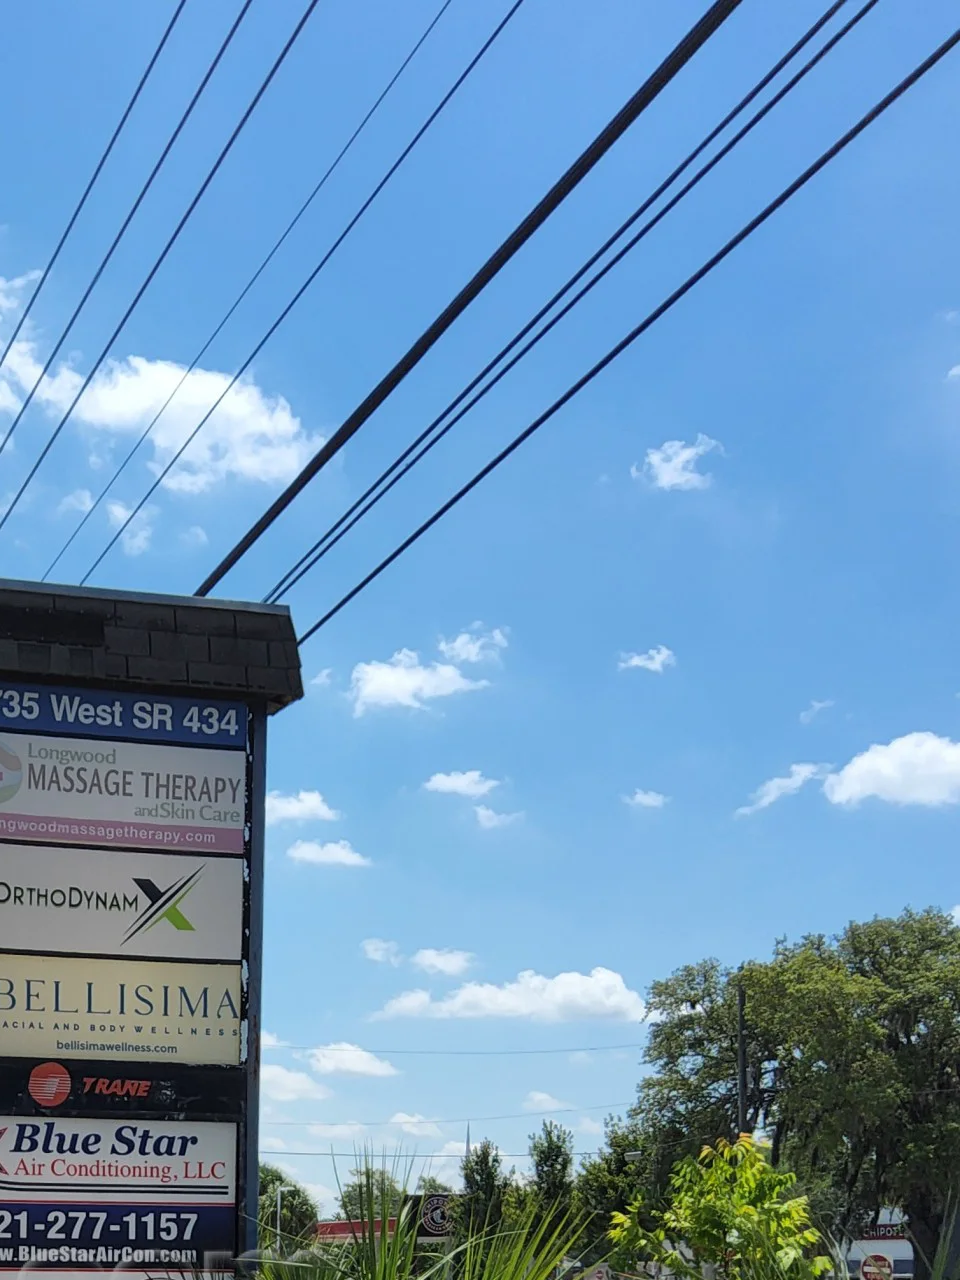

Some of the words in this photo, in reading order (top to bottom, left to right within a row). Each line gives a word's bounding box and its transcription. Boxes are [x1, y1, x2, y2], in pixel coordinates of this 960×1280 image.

[50, 693, 123, 727] West
[133, 702, 173, 731] SR
[183, 706, 239, 736] 434
[28, 742, 116, 764] Longwood
[28, 763, 135, 797] MASSAGE
[141, 771, 241, 804] THERAPY
[199, 805, 241, 823] Care
[53, 1022, 81, 1031] AND
[89, 1023, 127, 1033] BODY
[134, 1025, 239, 1037] WELLNESS
[56, 1040, 178, 1054] bellisimawellness.com
[82, 1077, 152, 1098] TRANE
[10, 1122, 101, 1155] Blue
[110, 1125, 199, 1157] Star
[13, 1158, 44, 1177] Air
[50, 1159, 178, 1183] Conditioning,
[183, 1161, 226, 1180] LLC
[863, 1226, 904, 1237] CHIPOTL
